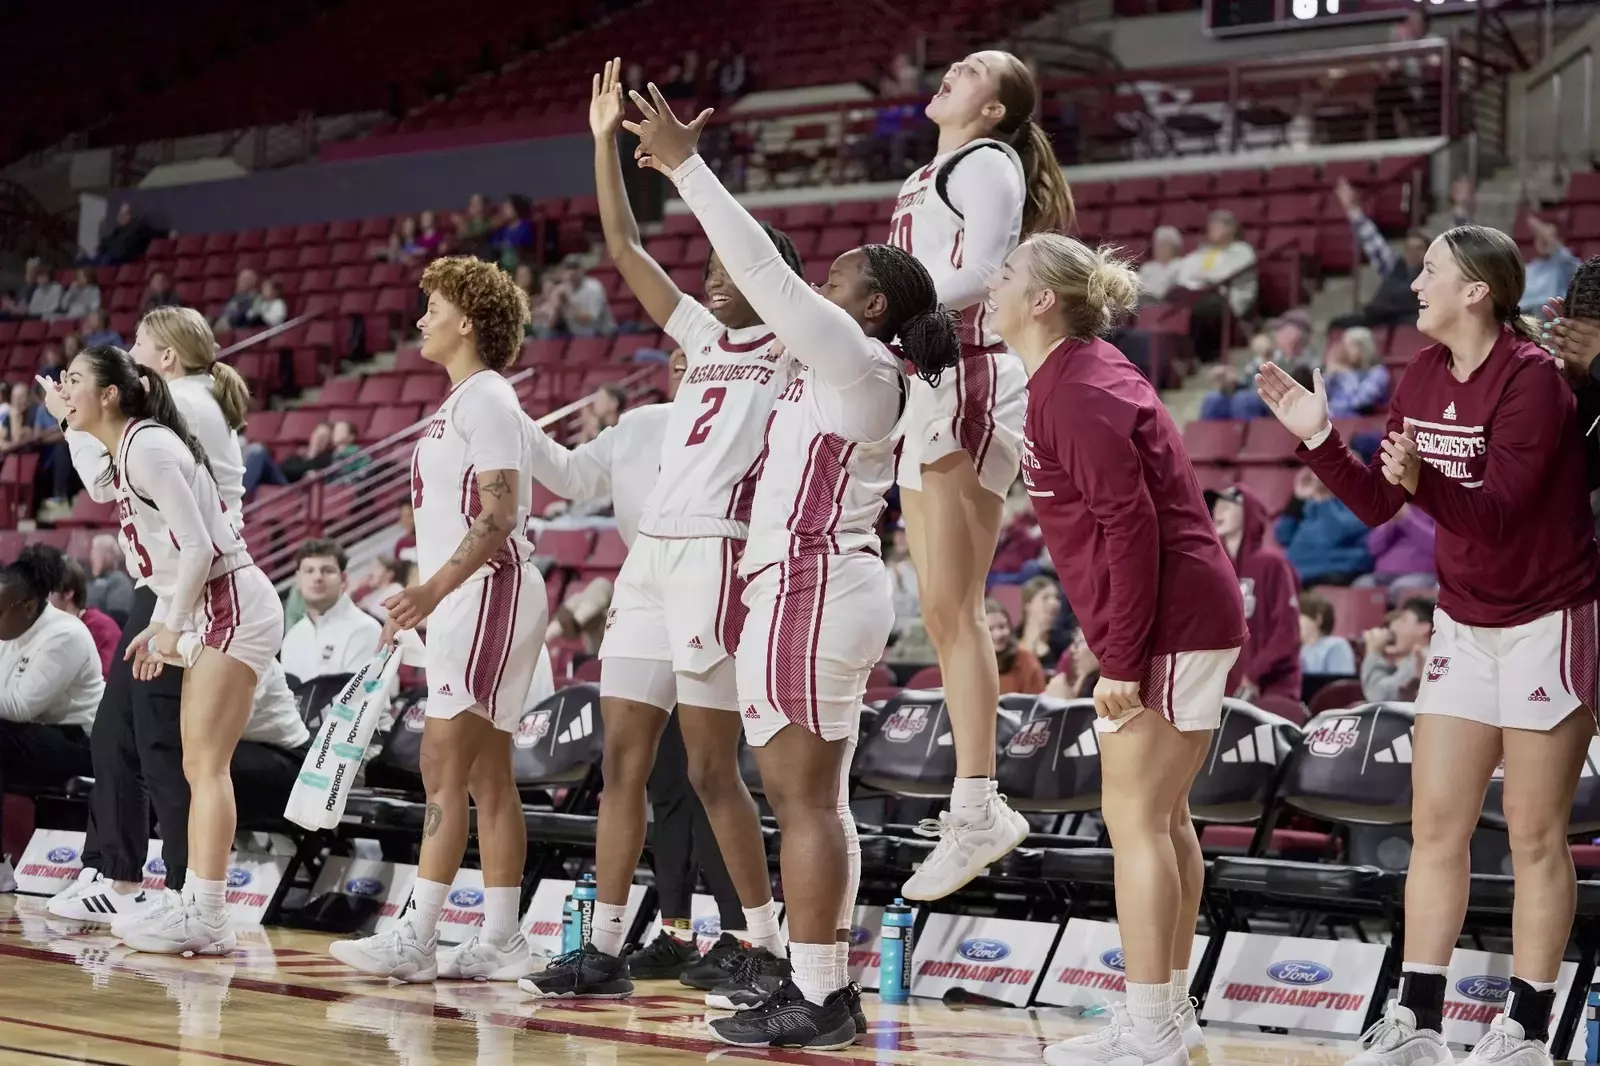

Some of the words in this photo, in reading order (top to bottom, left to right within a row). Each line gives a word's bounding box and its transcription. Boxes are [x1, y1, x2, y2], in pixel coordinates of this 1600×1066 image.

[684, 386, 728, 447] 2
[1413, 431, 1487, 458] SSACHUSETTS
[1527, 695, 1551, 703] adidas
[315, 721, 338, 770] POWERADE
[1306, 727, 1356, 747] MASS
[325, 762, 347, 812] POWERADE
[20, 864, 81, 880] NORTHAMPTO
[582, 900, 592, 946] POWERA
[966, 941, 1002, 959] Ford
[917, 959, 1034, 986] NORTHAMPTON
[1057, 967, 1127, 993] NORTHA
[1278, 963, 1319, 983] Ford
[1222, 981, 1366, 1012] NORTHAMPTON
